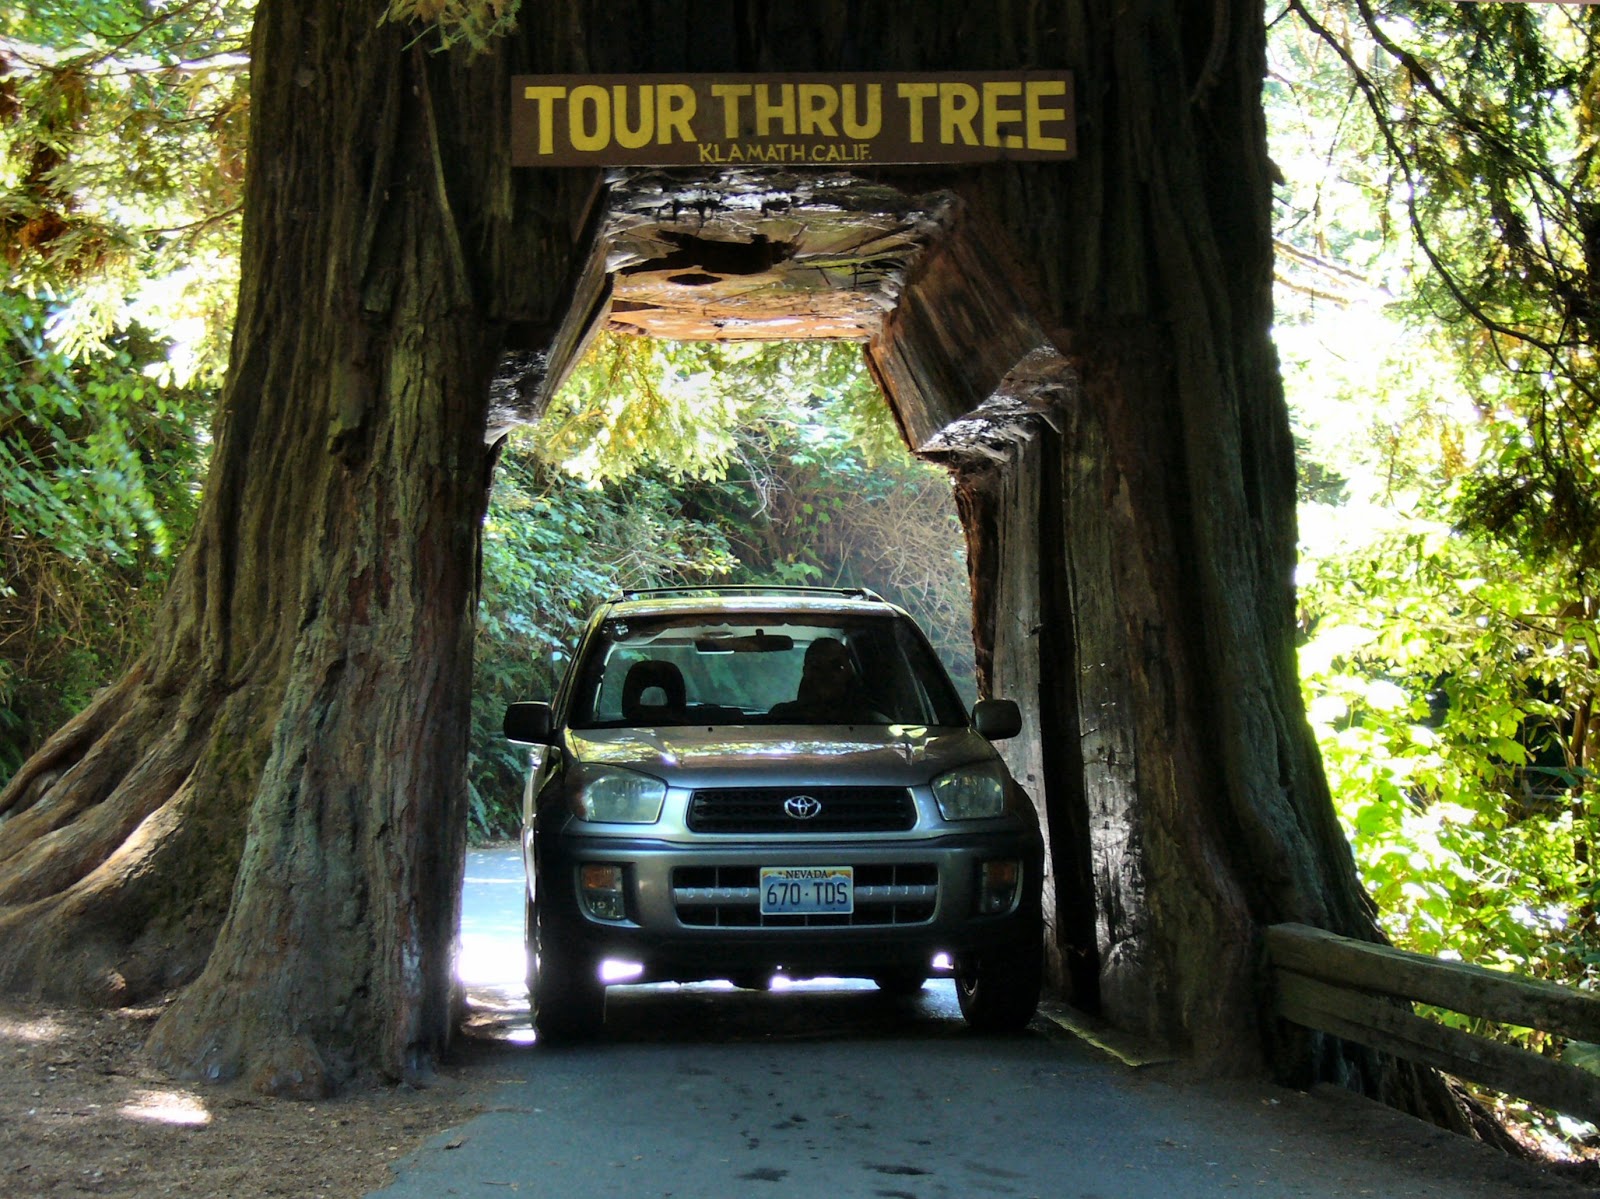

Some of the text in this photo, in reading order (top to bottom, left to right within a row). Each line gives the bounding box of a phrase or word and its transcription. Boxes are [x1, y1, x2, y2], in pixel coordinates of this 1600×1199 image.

[524, 81, 1067, 155] TOUR THRU TREE
[785, 869, 829, 879] NEVADA
